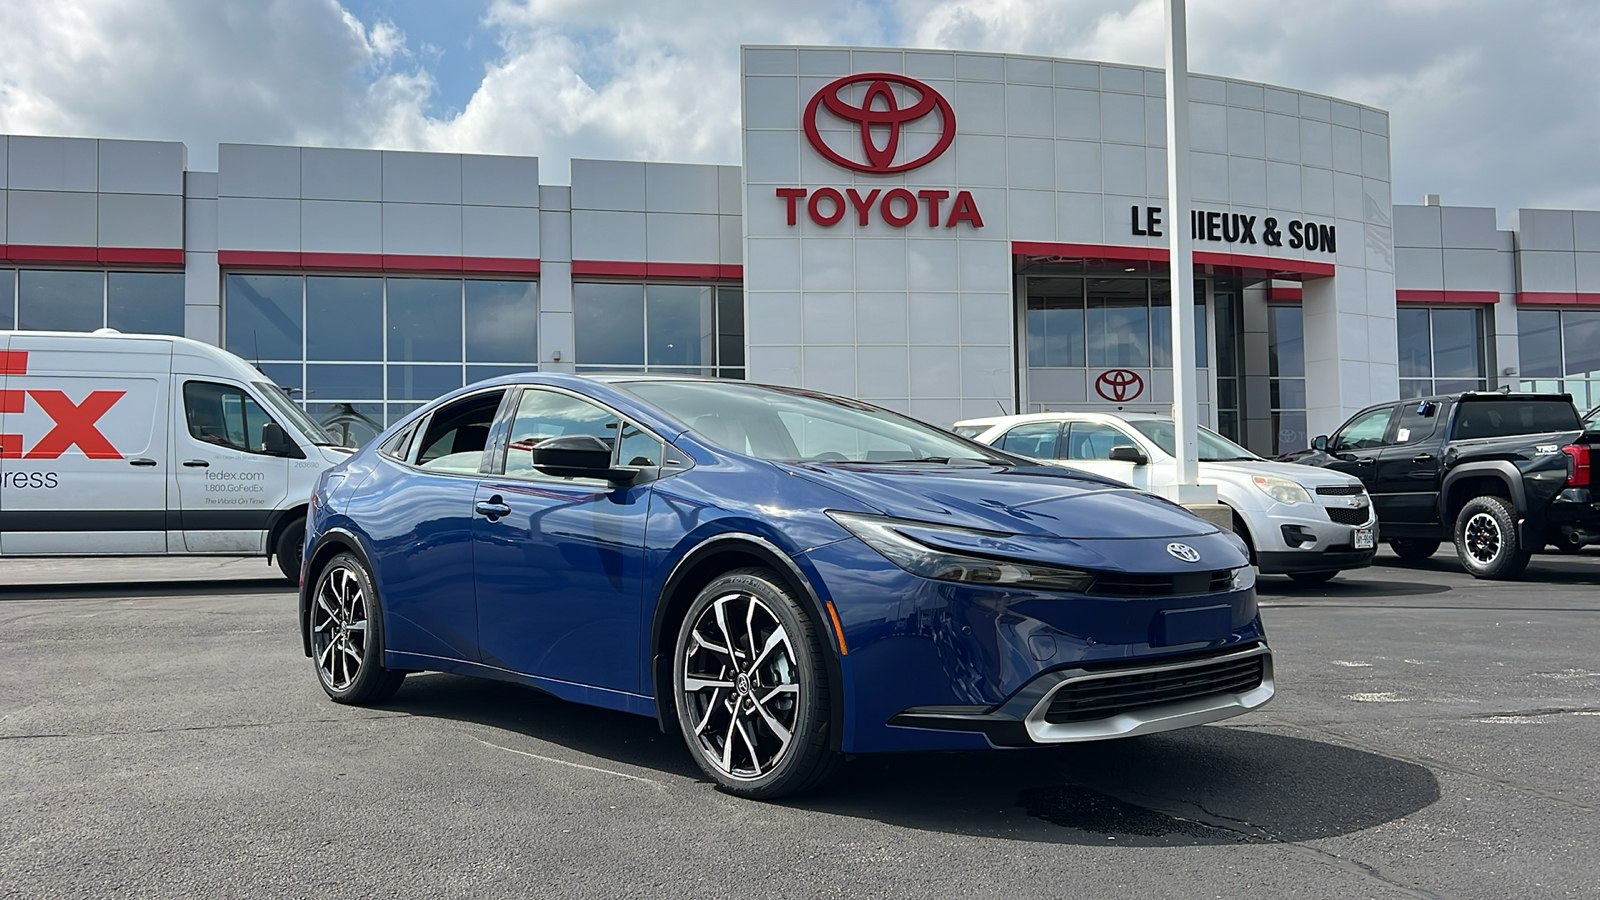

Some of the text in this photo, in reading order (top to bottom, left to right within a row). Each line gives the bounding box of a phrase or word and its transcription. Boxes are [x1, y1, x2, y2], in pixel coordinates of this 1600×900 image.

[776, 187, 984, 228] TOYOTA
[1132, 205, 1163, 237] LE
[1263, 217, 1282, 247] &
[1289, 220, 1336, 253] SON
[0, 471, 58, 488] ress
[205, 469, 265, 481] fedex.com
[204, 484, 264, 492] 1.800.GoFedEx
